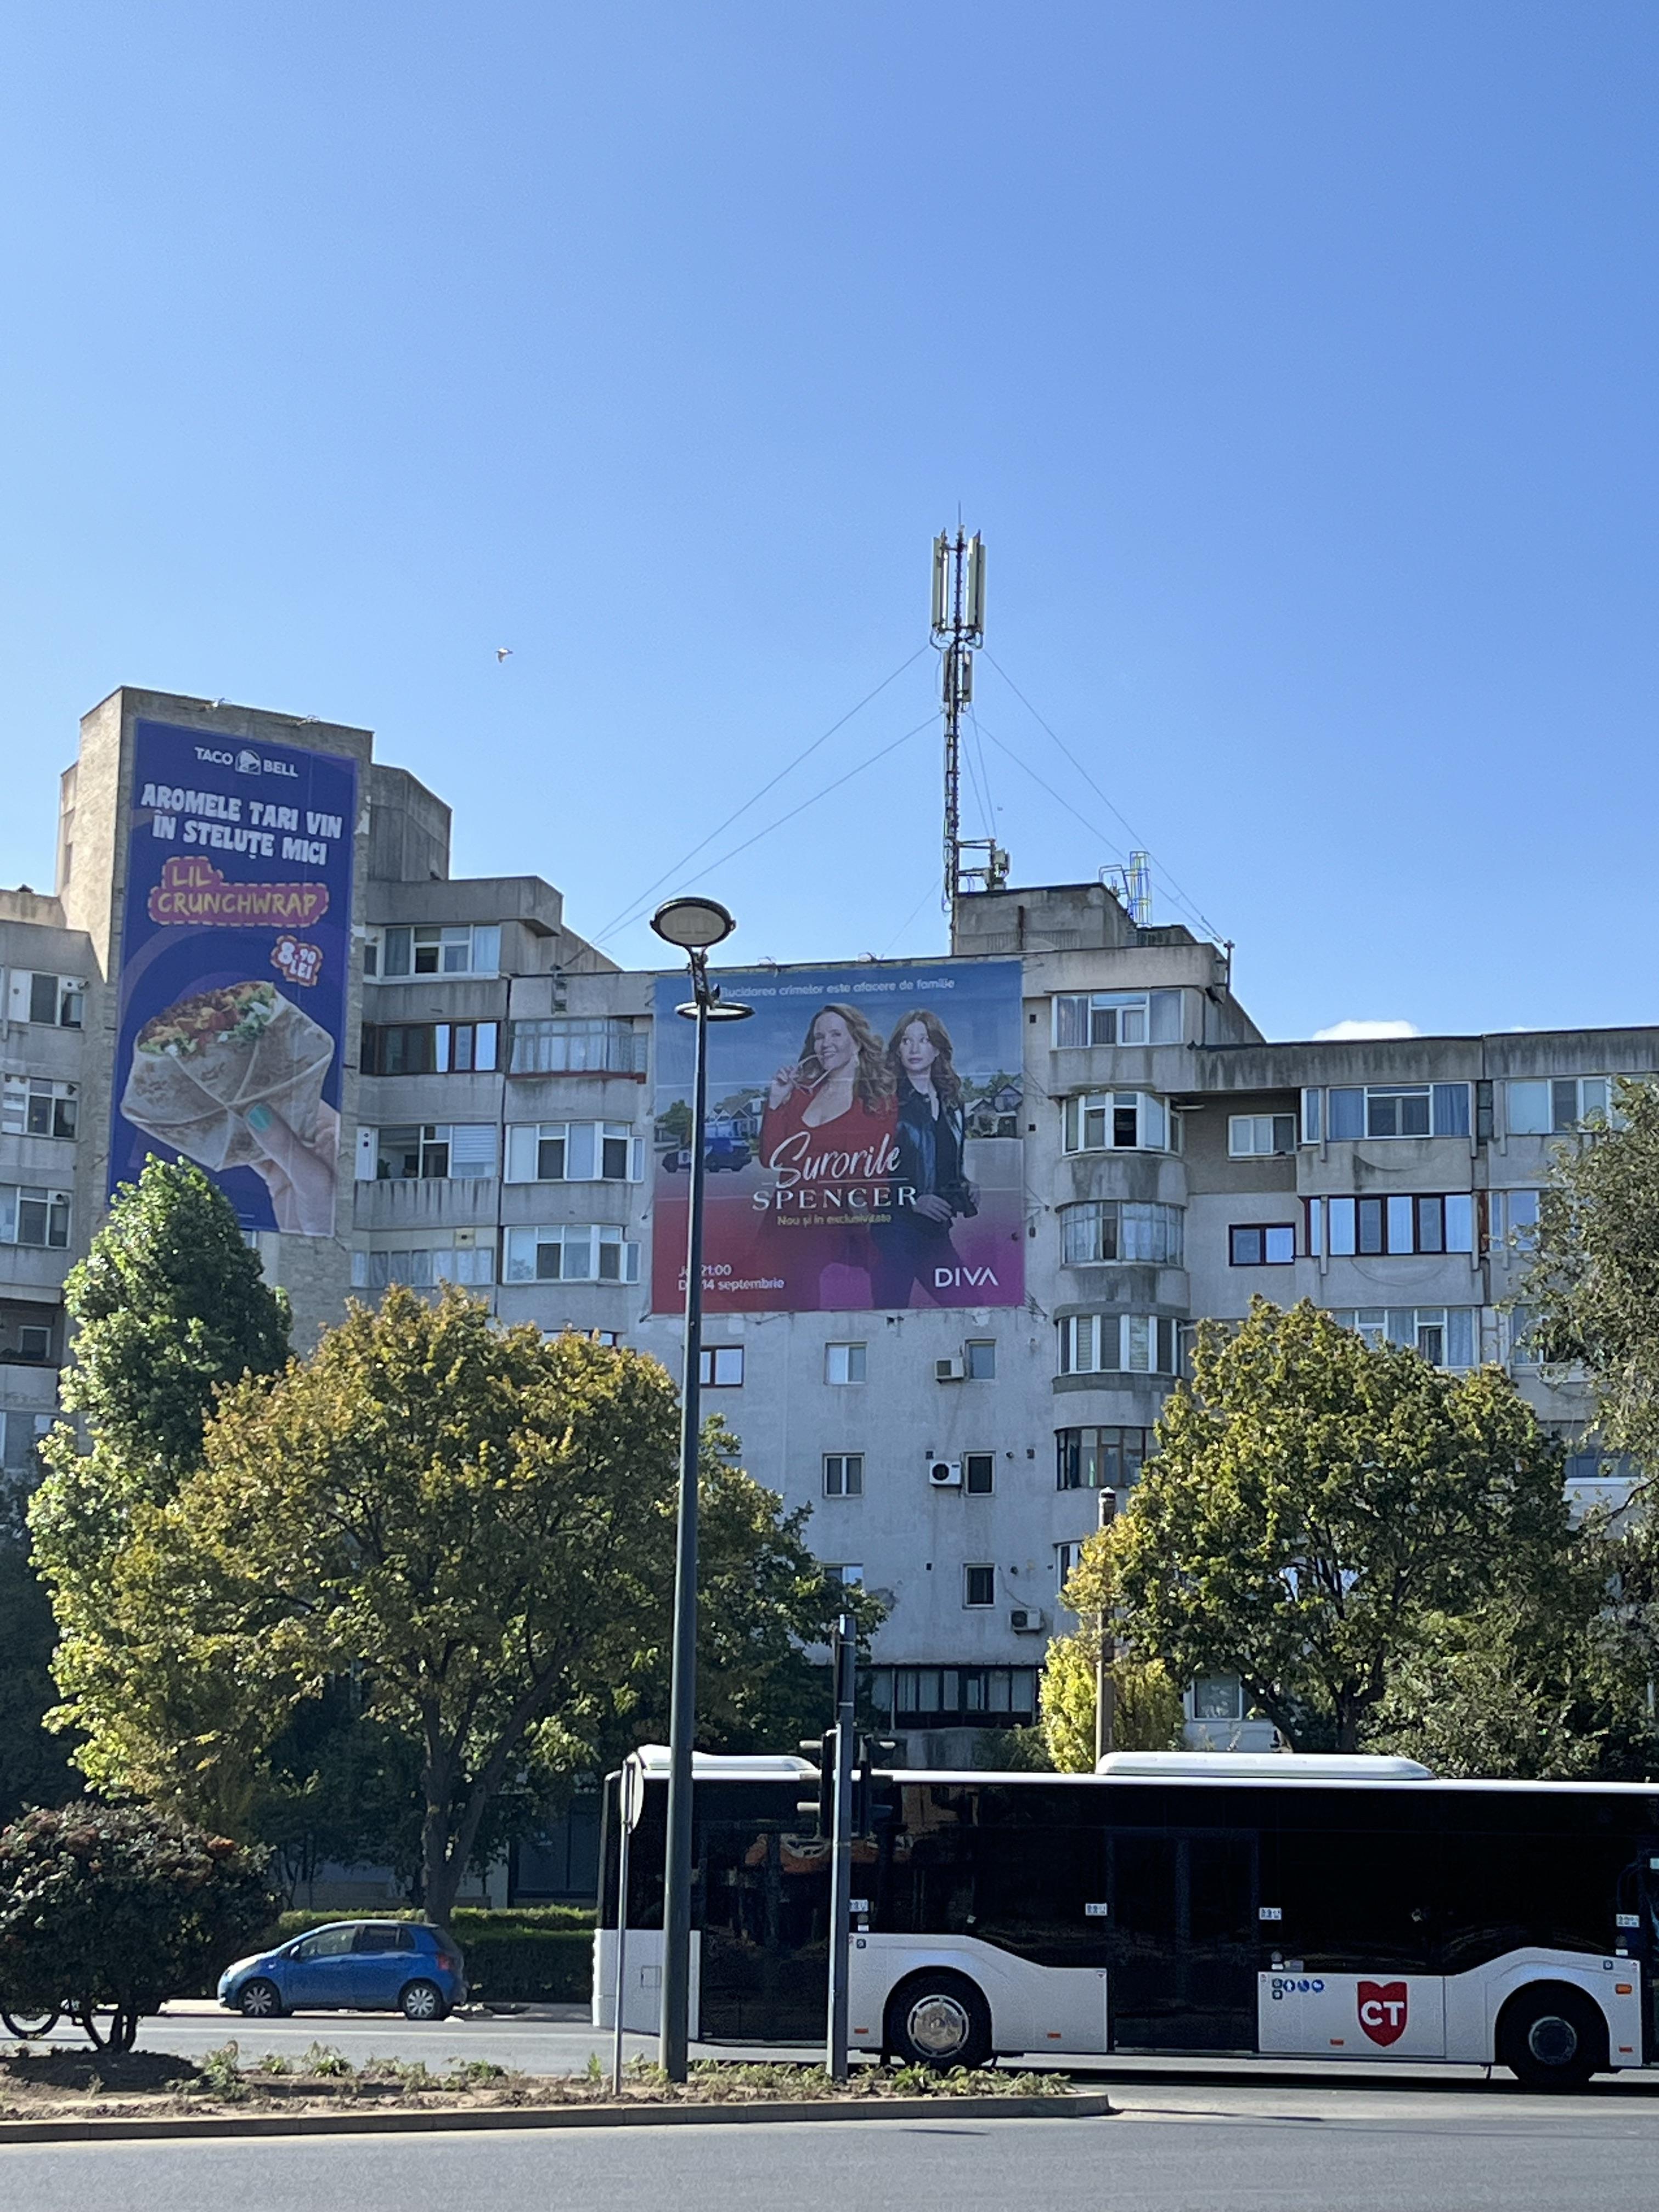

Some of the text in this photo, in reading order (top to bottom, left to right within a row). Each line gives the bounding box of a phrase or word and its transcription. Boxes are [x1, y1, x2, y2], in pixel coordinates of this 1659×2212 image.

[194, 747, 298, 777] TACO BELL
[140, 783, 342, 839] AROMELE TARI VIN
[152, 810, 177, 840] ÎN
[282, 837, 328, 866] MICI
[172, 865, 212, 887] LIL
[157, 891, 318, 916] CRUNCHWRAP
[289, 960, 313, 979] LEI
[826, 983, 850, 993] este
[899, 980, 913, 990] de
[769, 1131, 901, 1188] Surorile
[752, 1186, 917, 1211] SPENCER
[934, 1266, 999, 1287] DIVA
[1361, 2000, 1405, 2026] CT
